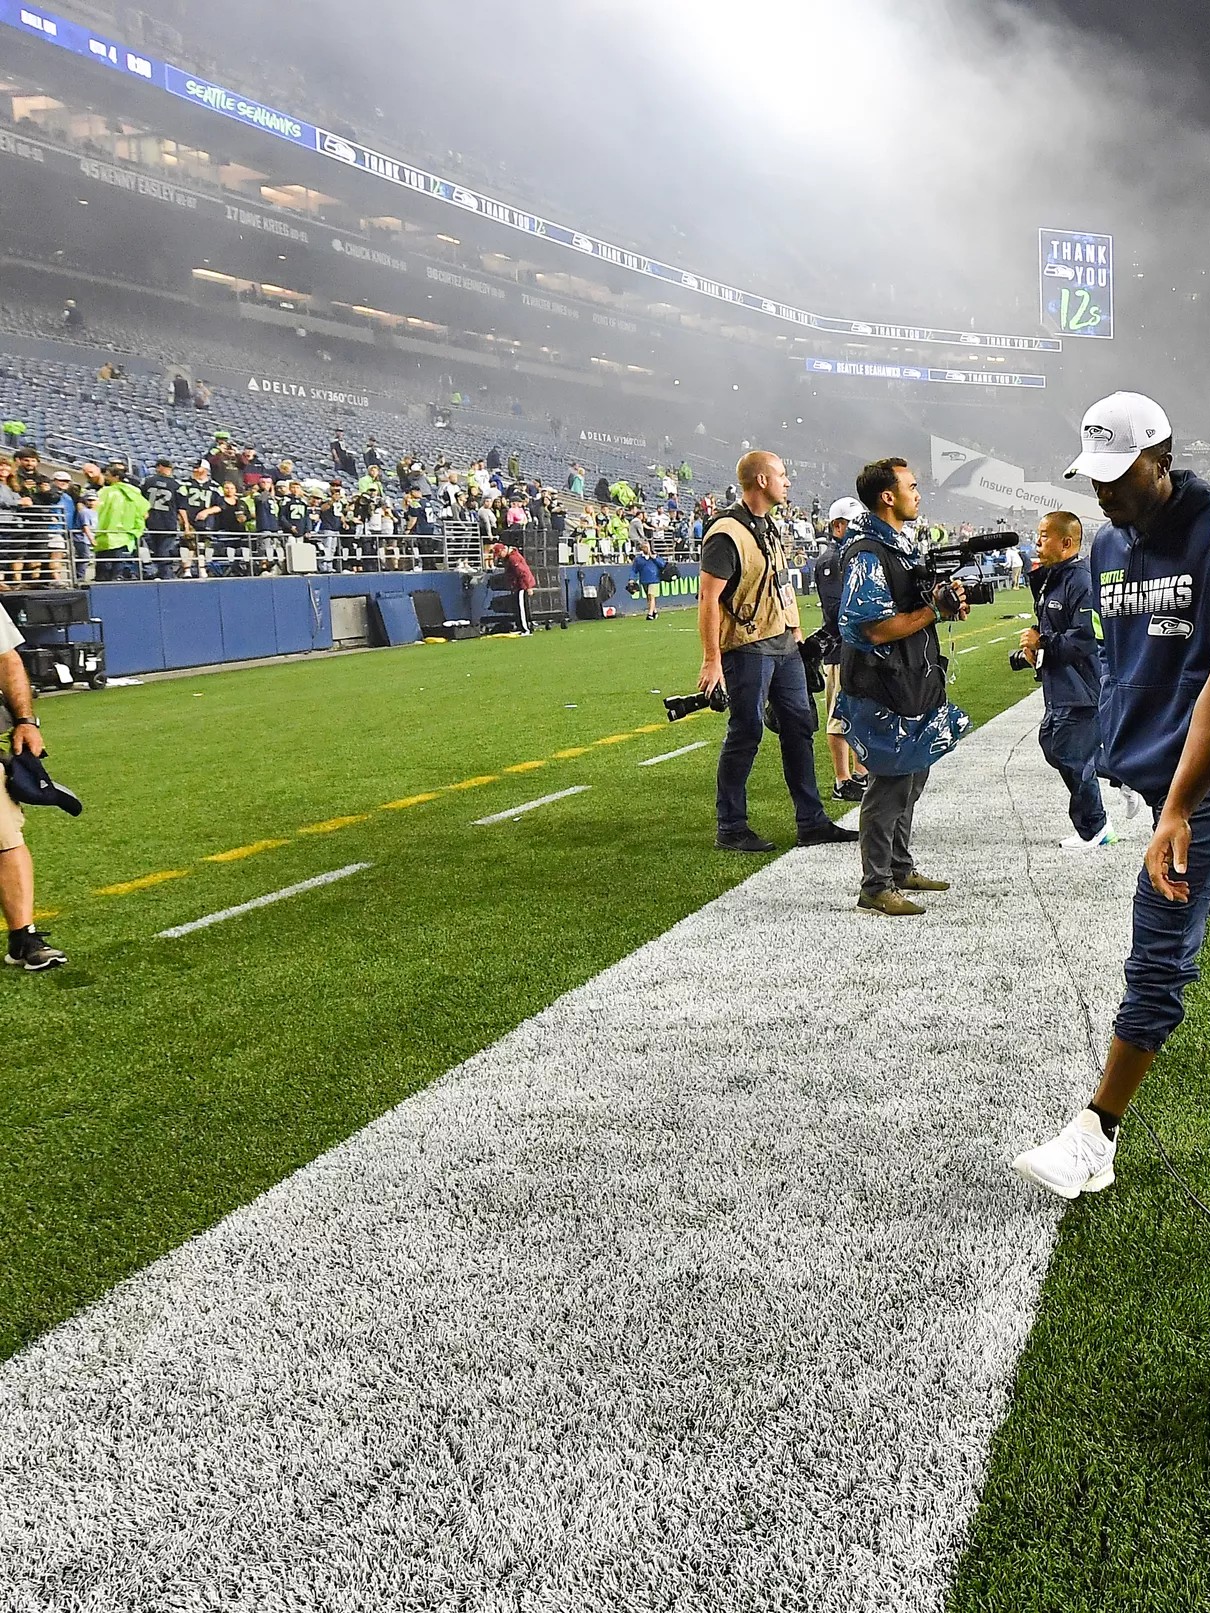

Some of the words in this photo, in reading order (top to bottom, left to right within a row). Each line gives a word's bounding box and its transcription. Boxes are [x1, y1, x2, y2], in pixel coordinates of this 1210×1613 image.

[185, 80, 236, 111] SEATTLE
[236, 101, 302, 138] SEAHAWKS
[363, 151, 400, 181] THANK
[403, 167, 425, 190] YOU
[480, 199, 510, 223] THANK
[513, 211, 530, 230] YOU
[597, 243, 621, 263] THANK
[624, 254, 638, 269] YOU
[1051, 240, 1107, 265] THANK
[1075, 266, 1107, 287] YOU
[1061, 288, 1101, 331] 12s
[875, 325, 901, 338] THANK
[904, 329, 920, 339] YOU
[986, 336, 1011, 347] THANK
[1014, 338, 1029, 348] YOU
[837, 362, 864, 375] SEATTLE
[864, 364, 901, 378] SEAHAWKS
[968, 373, 993, 383] THANK
[996, 374, 1010, 384] YOU
[262, 379, 306, 397] DELTA
[587, 431, 612, 442] DELTA
[147, 487, 173, 512] 12
[188, 487, 213, 509] 24
[980, 476, 1013, 496] Insure
[1015, 488, 1063, 511] Carefully
[1100, 569, 1125, 585] SEATTLE
[1100, 574, 1193, 619] SEAHAWKS
